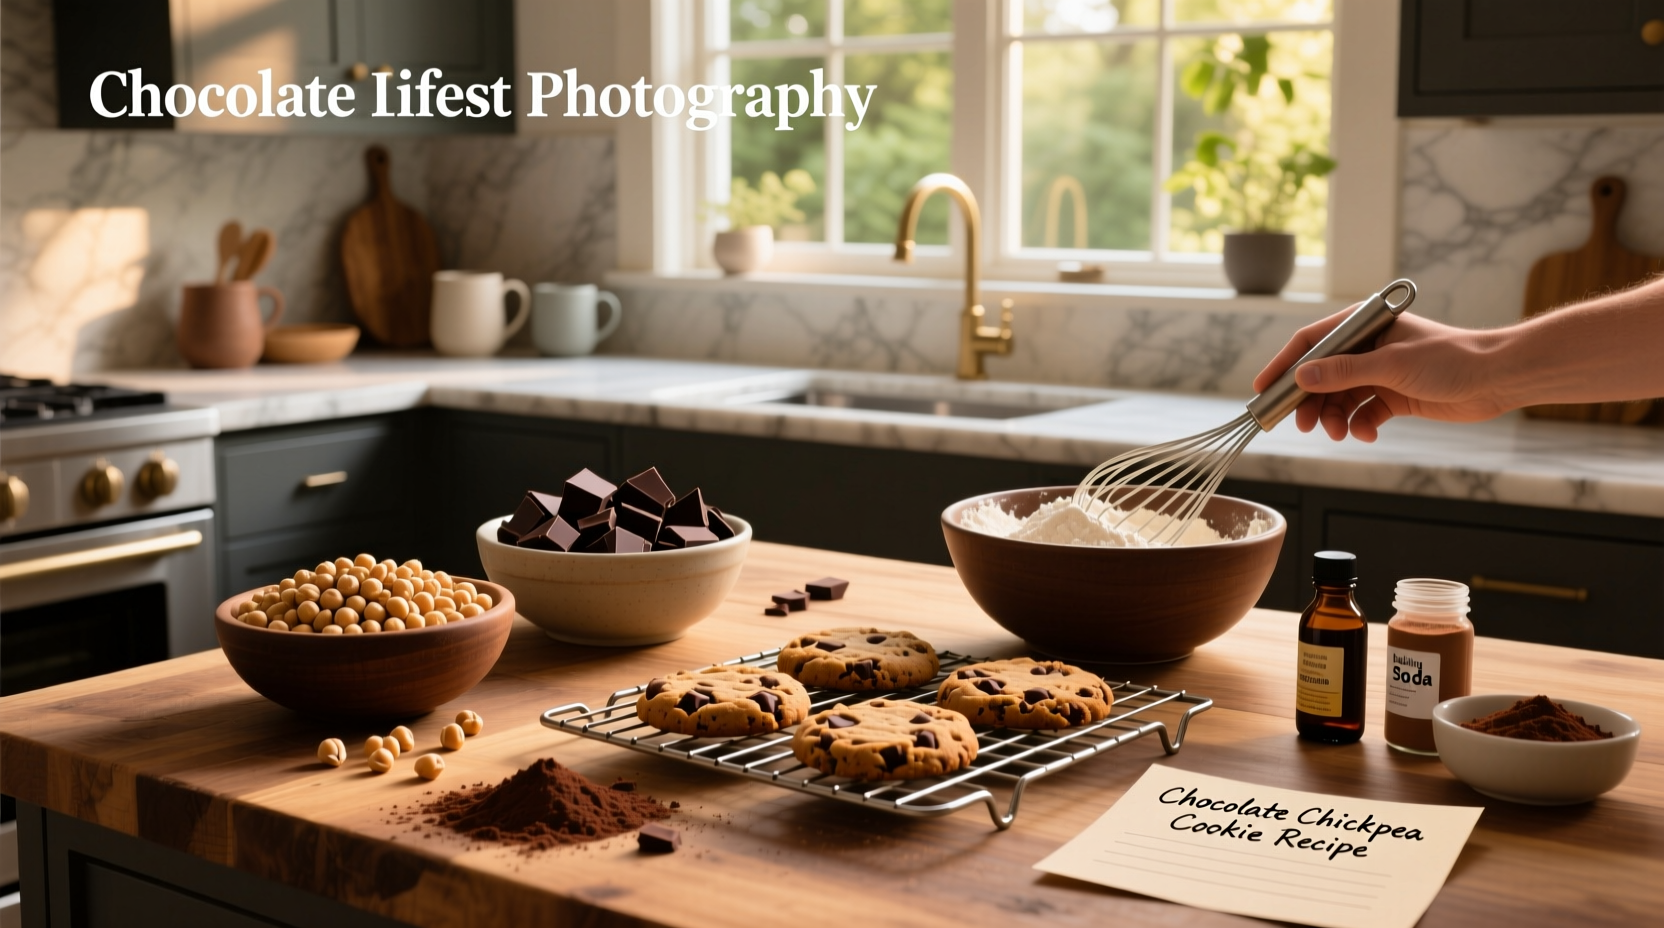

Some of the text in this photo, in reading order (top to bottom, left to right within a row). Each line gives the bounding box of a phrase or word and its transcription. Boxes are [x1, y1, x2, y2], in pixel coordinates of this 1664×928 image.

[1392, 665, 1433, 687] Soda
[1159, 787, 1424, 842] Chocolate Chickpea
[1170, 813, 1369, 861] Cookie Recipe
